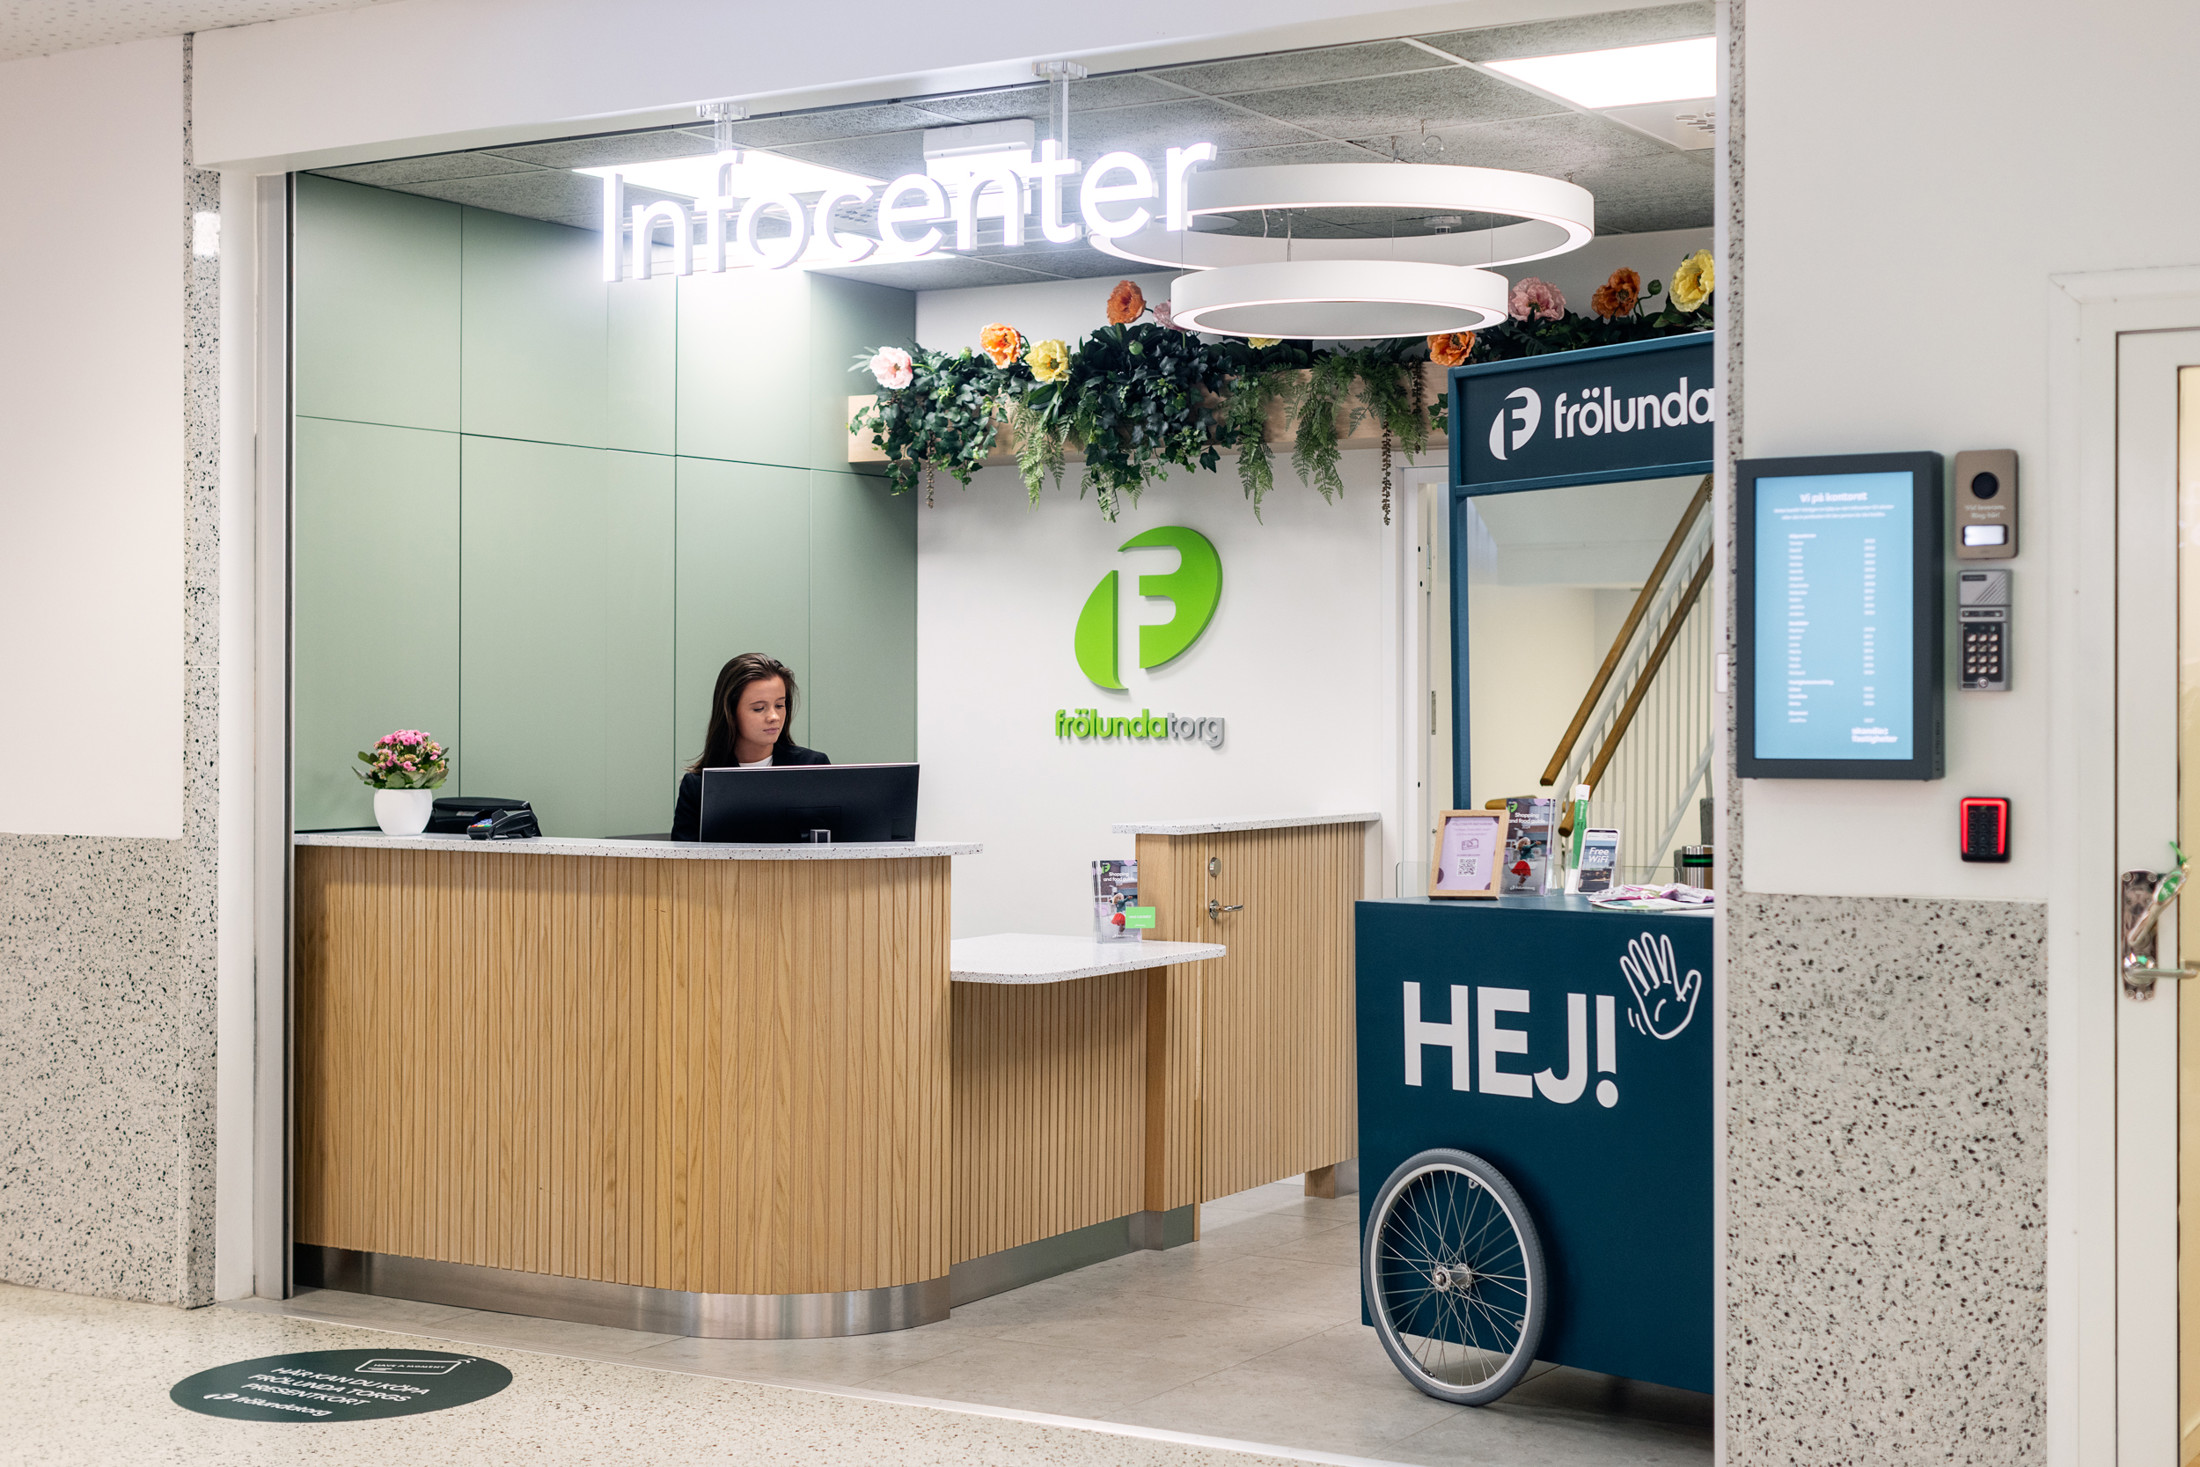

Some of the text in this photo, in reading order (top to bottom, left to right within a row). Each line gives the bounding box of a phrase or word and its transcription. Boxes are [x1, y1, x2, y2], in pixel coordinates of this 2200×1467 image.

[602, 138, 1218, 283] Infocenter
[1554, 376, 1715, 440] frölunda
[1055, 708, 1226, 749] frölundatorg
[1588, 846, 1610, 855] Free
[1588, 855, 1609, 863] WiFi
[1403, 980, 1619, 1109] HEJ!
[240, 1383, 372, 1406] PRESENTKORT
[247, 1373, 412, 1402] FRÖLUNDA TORGS
[270, 1367, 431, 1396] HÄR KAN DU KÖPA
[231, 1396, 333, 1417] frölundatorg
